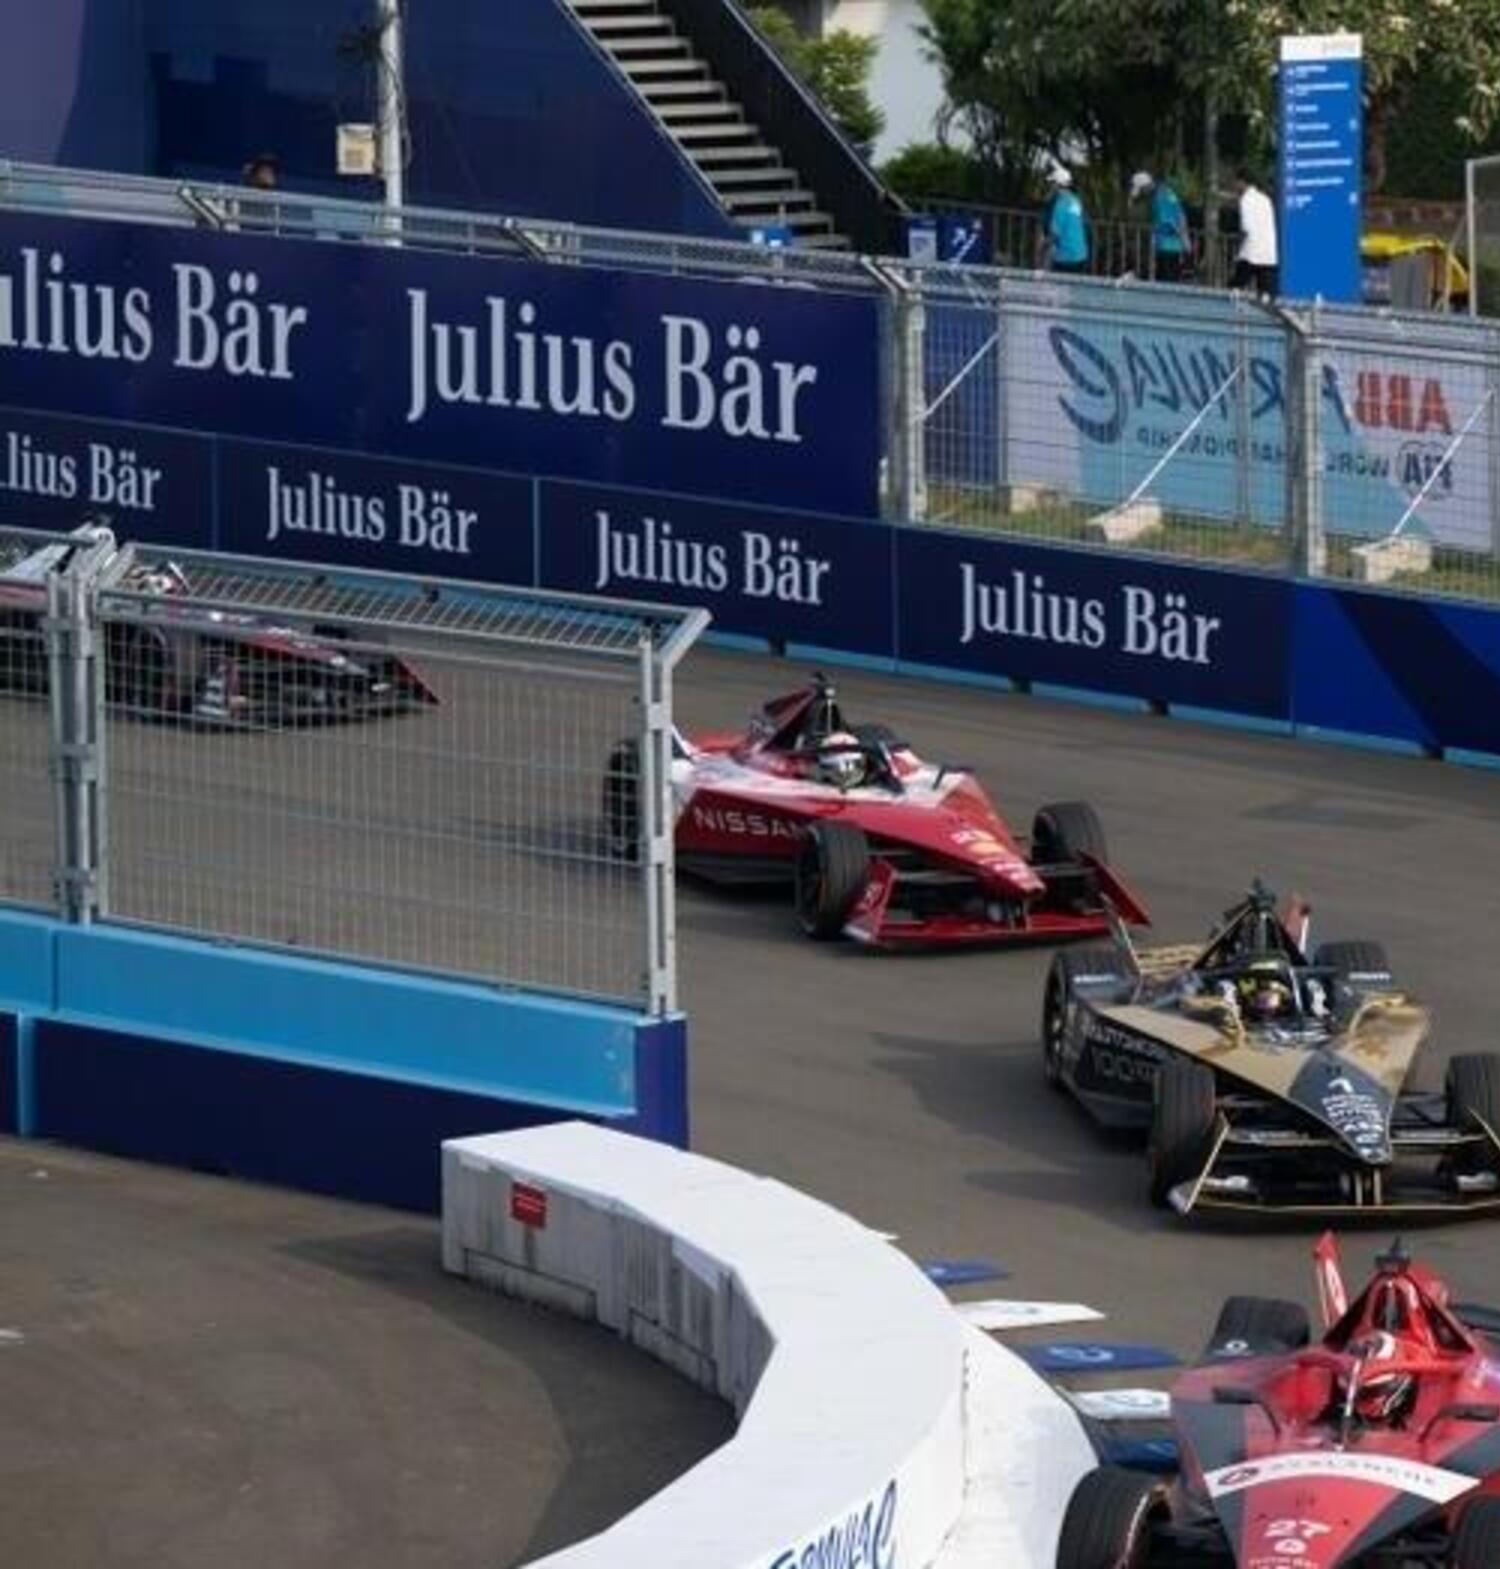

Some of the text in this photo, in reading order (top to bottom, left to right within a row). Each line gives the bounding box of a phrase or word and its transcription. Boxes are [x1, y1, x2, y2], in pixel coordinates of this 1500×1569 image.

[172, 262, 308, 380] Bär
[406, 287, 818, 443] Julius Bär
[0, 431, 162, 511] lius Bär
[266, 466, 479, 554] Julius Bär
[595, 511, 830, 606] Julius Bär
[961, 563, 1221, 665] Julius Bär
[1264, 1518, 1332, 1540] 27
